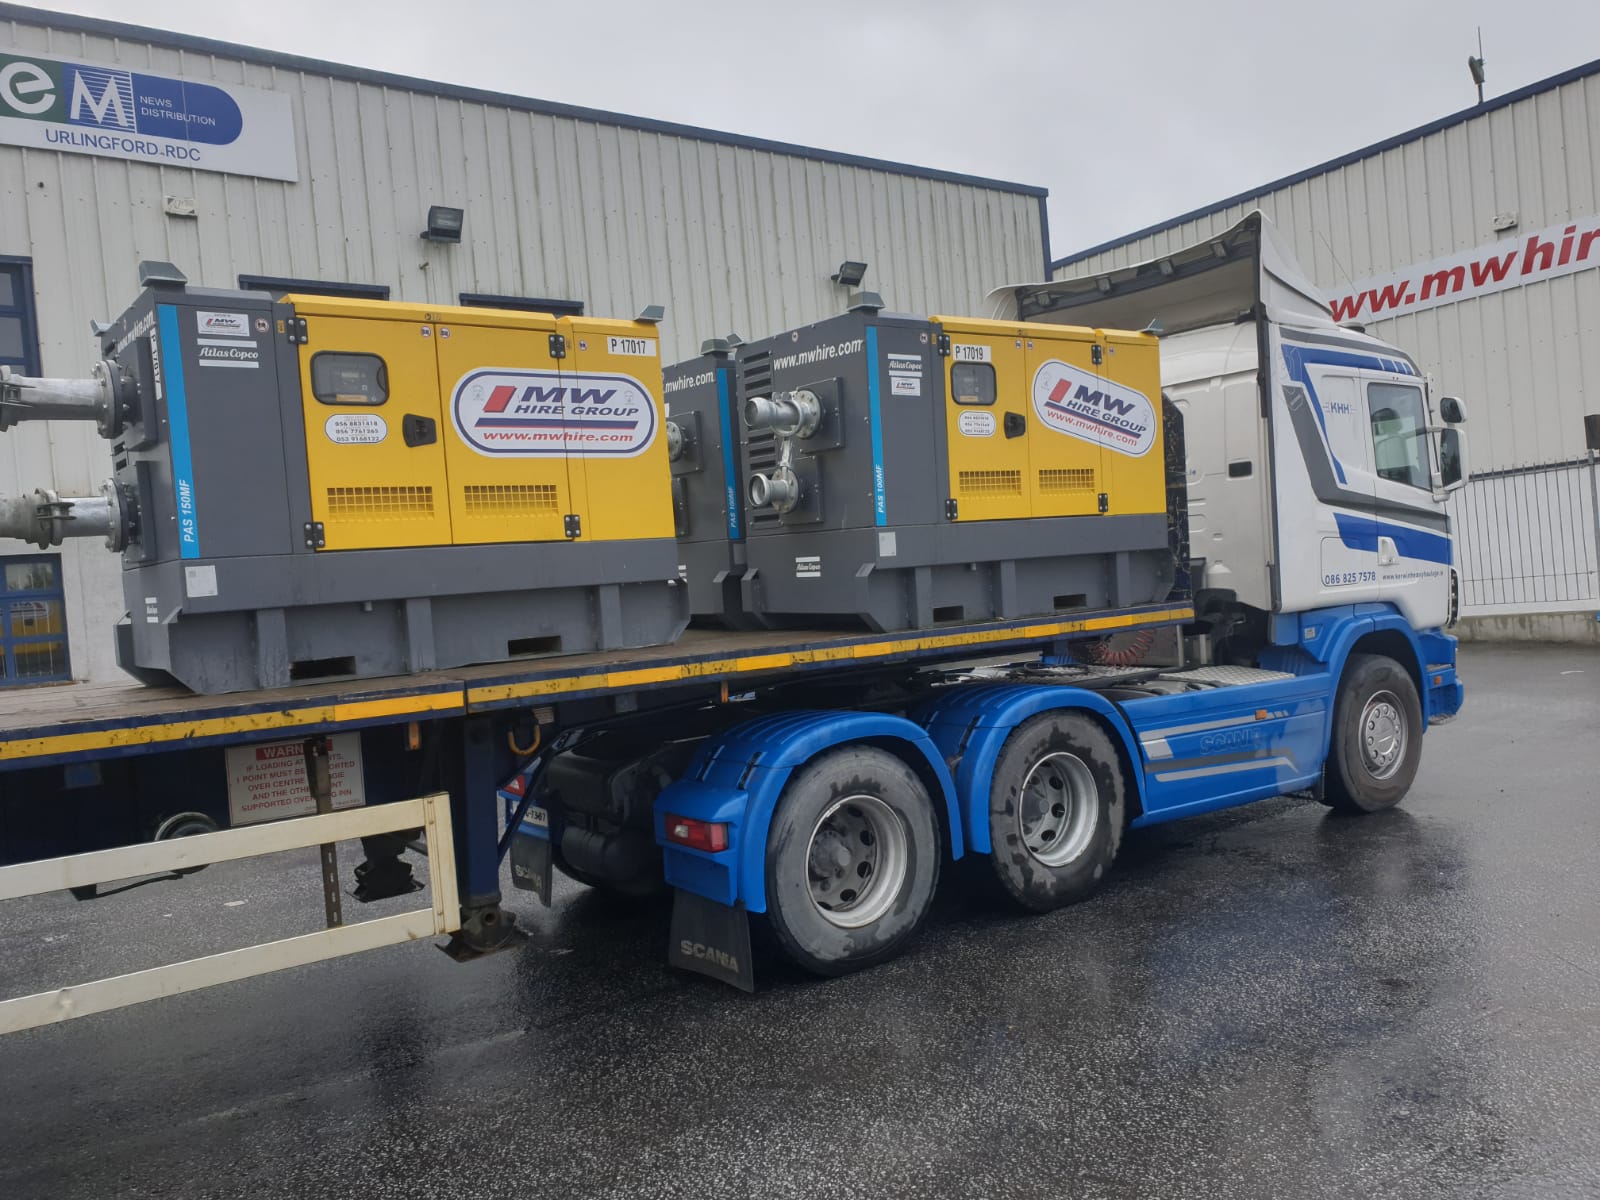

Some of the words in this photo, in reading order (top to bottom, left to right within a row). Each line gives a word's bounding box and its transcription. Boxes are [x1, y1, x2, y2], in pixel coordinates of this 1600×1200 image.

[139, 94, 173, 109] NEWS
[140, 106, 217, 127] DISTRIBUTION
[45, 129, 159, 156] URLINGFORD
[199, 347, 229, 358] Atlas
[229, 348, 259, 360] Copco
[611, 338, 617, 352] P
[621, 339, 646, 354] 17017
[773, 337, 864, 371] www.mwhire.com
[955, 346, 961, 359] P
[963, 347, 984, 361] 17019
[521, 386, 618, 405] MW
[1073, 384, 1136, 417] MW
[514, 404, 566, 416] HIRE
[571, 406, 640, 417] GROUP
[1330, 401, 1350, 415] KHH
[1066, 399, 1100, 418] HIRE
[1102, 410, 1148, 434] GROUP
[483, 430, 634, 442] www.mwhire.com
[1047, 409, 1138, 447] www.mwhire.com
[875, 464, 884, 492] 100MF
[178, 479, 193, 515] 150MF
[877, 494, 885, 513] PAS
[183, 519, 195, 543] PAS
[1324, 574, 1341, 584] 086
[1343, 573, 1357, 583] 825
[1358, 571, 1376, 582] 7578
[256, 760, 293, 771] LOADING
[243, 773, 267, 783] POINT
[270, 770, 293, 779] MUST
[247, 782, 271, 792] OVER
[273, 777, 305, 787] CENTRE
[252, 792, 271, 801] AND
[241, 798, 293, 812] SUPPORTED
[680, 939, 739, 973] SCANIA
